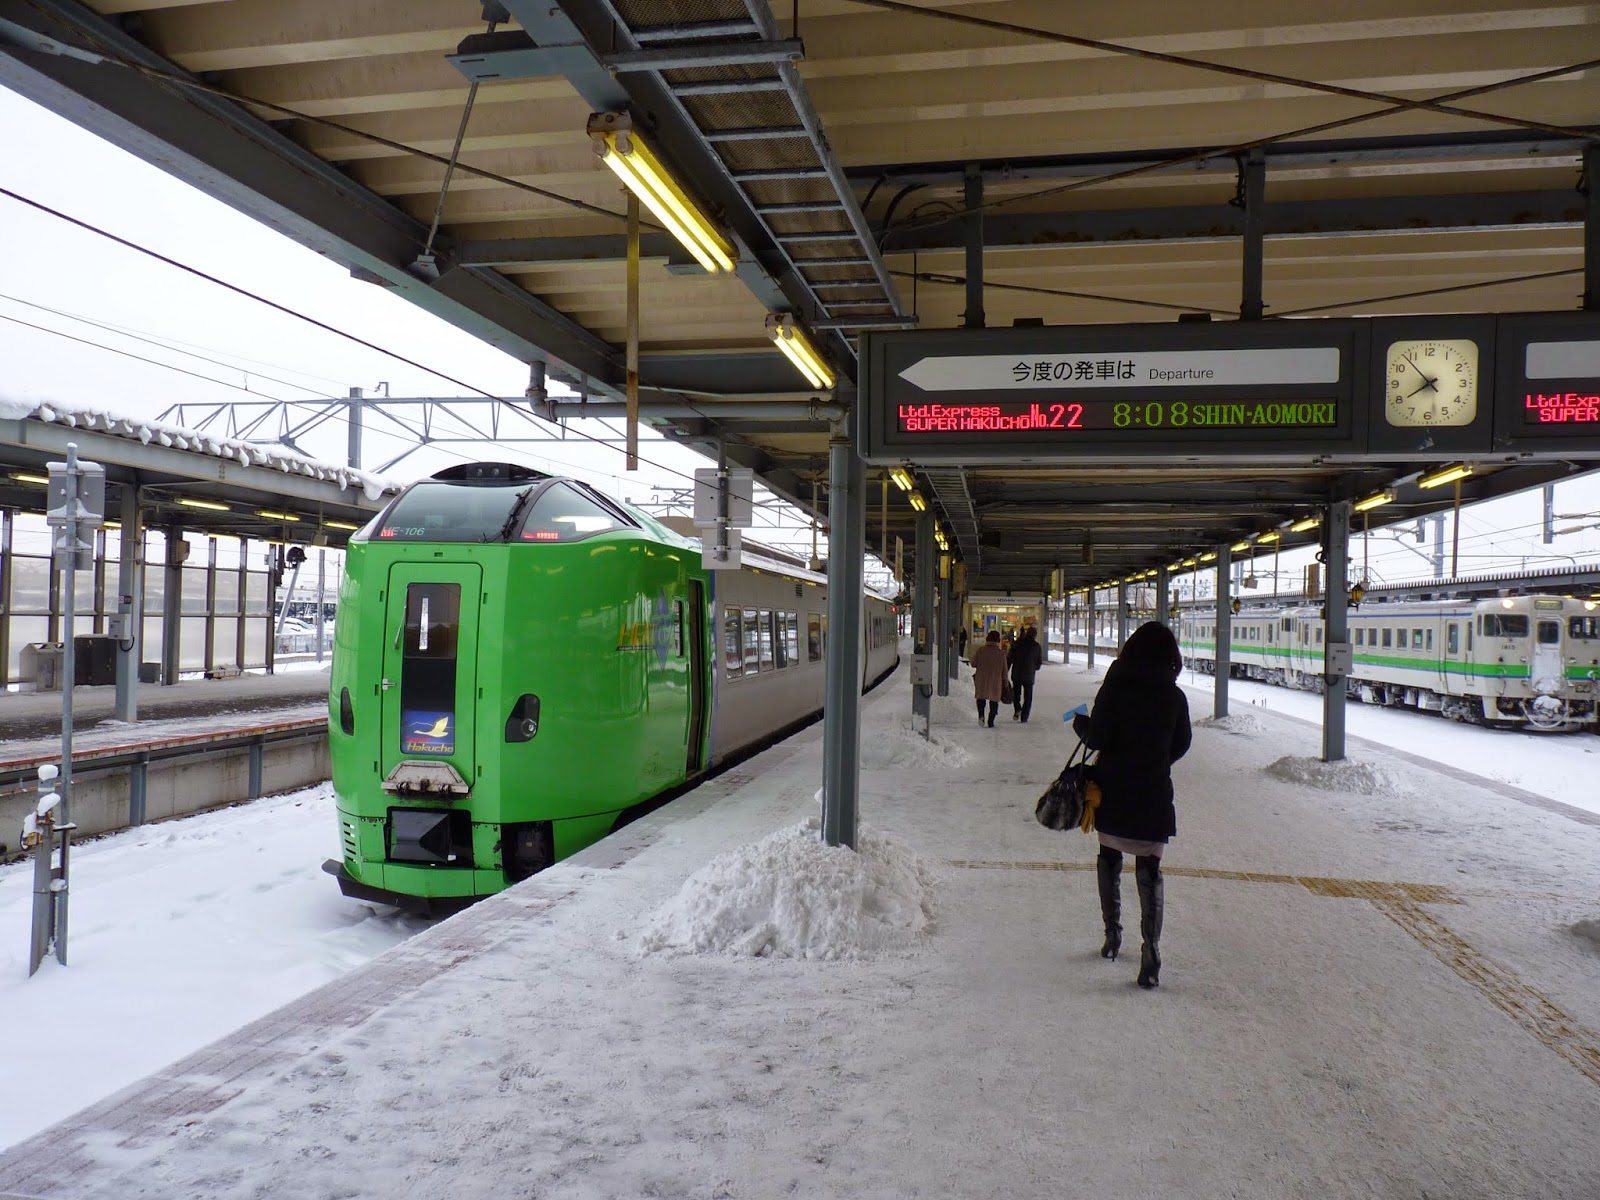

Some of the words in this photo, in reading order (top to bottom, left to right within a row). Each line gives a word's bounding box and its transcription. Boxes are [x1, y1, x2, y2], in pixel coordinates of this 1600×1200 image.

[1410, 352, 1418, 361] 11
[1425, 348, 1435, 356] 12
[1445, 352, 1449, 360] 1
[1012, 359, 1136, 382] 今度の発車は
[1396, 364, 1405, 373] 10
[1456, 364, 1463, 372] 2
[1149, 367, 1214, 381] Departure
[1391, 380, 1399, 389] 9
[1460, 380, 1467, 388] 3
[1395, 396, 1403, 404] 8
[1454, 396, 1461, 404] 4
[899, 404, 1001, 418] Ltd.Express
[1408, 408, 1415, 416] 7
[1441, 407, 1449, 416] 5
[1540, 407, 1598, 422] SUPER
[1424, 412, 1432, 420] 6
[906, 417, 957, 431] SUPER
[407, 742, 454, 752] Hakucho
